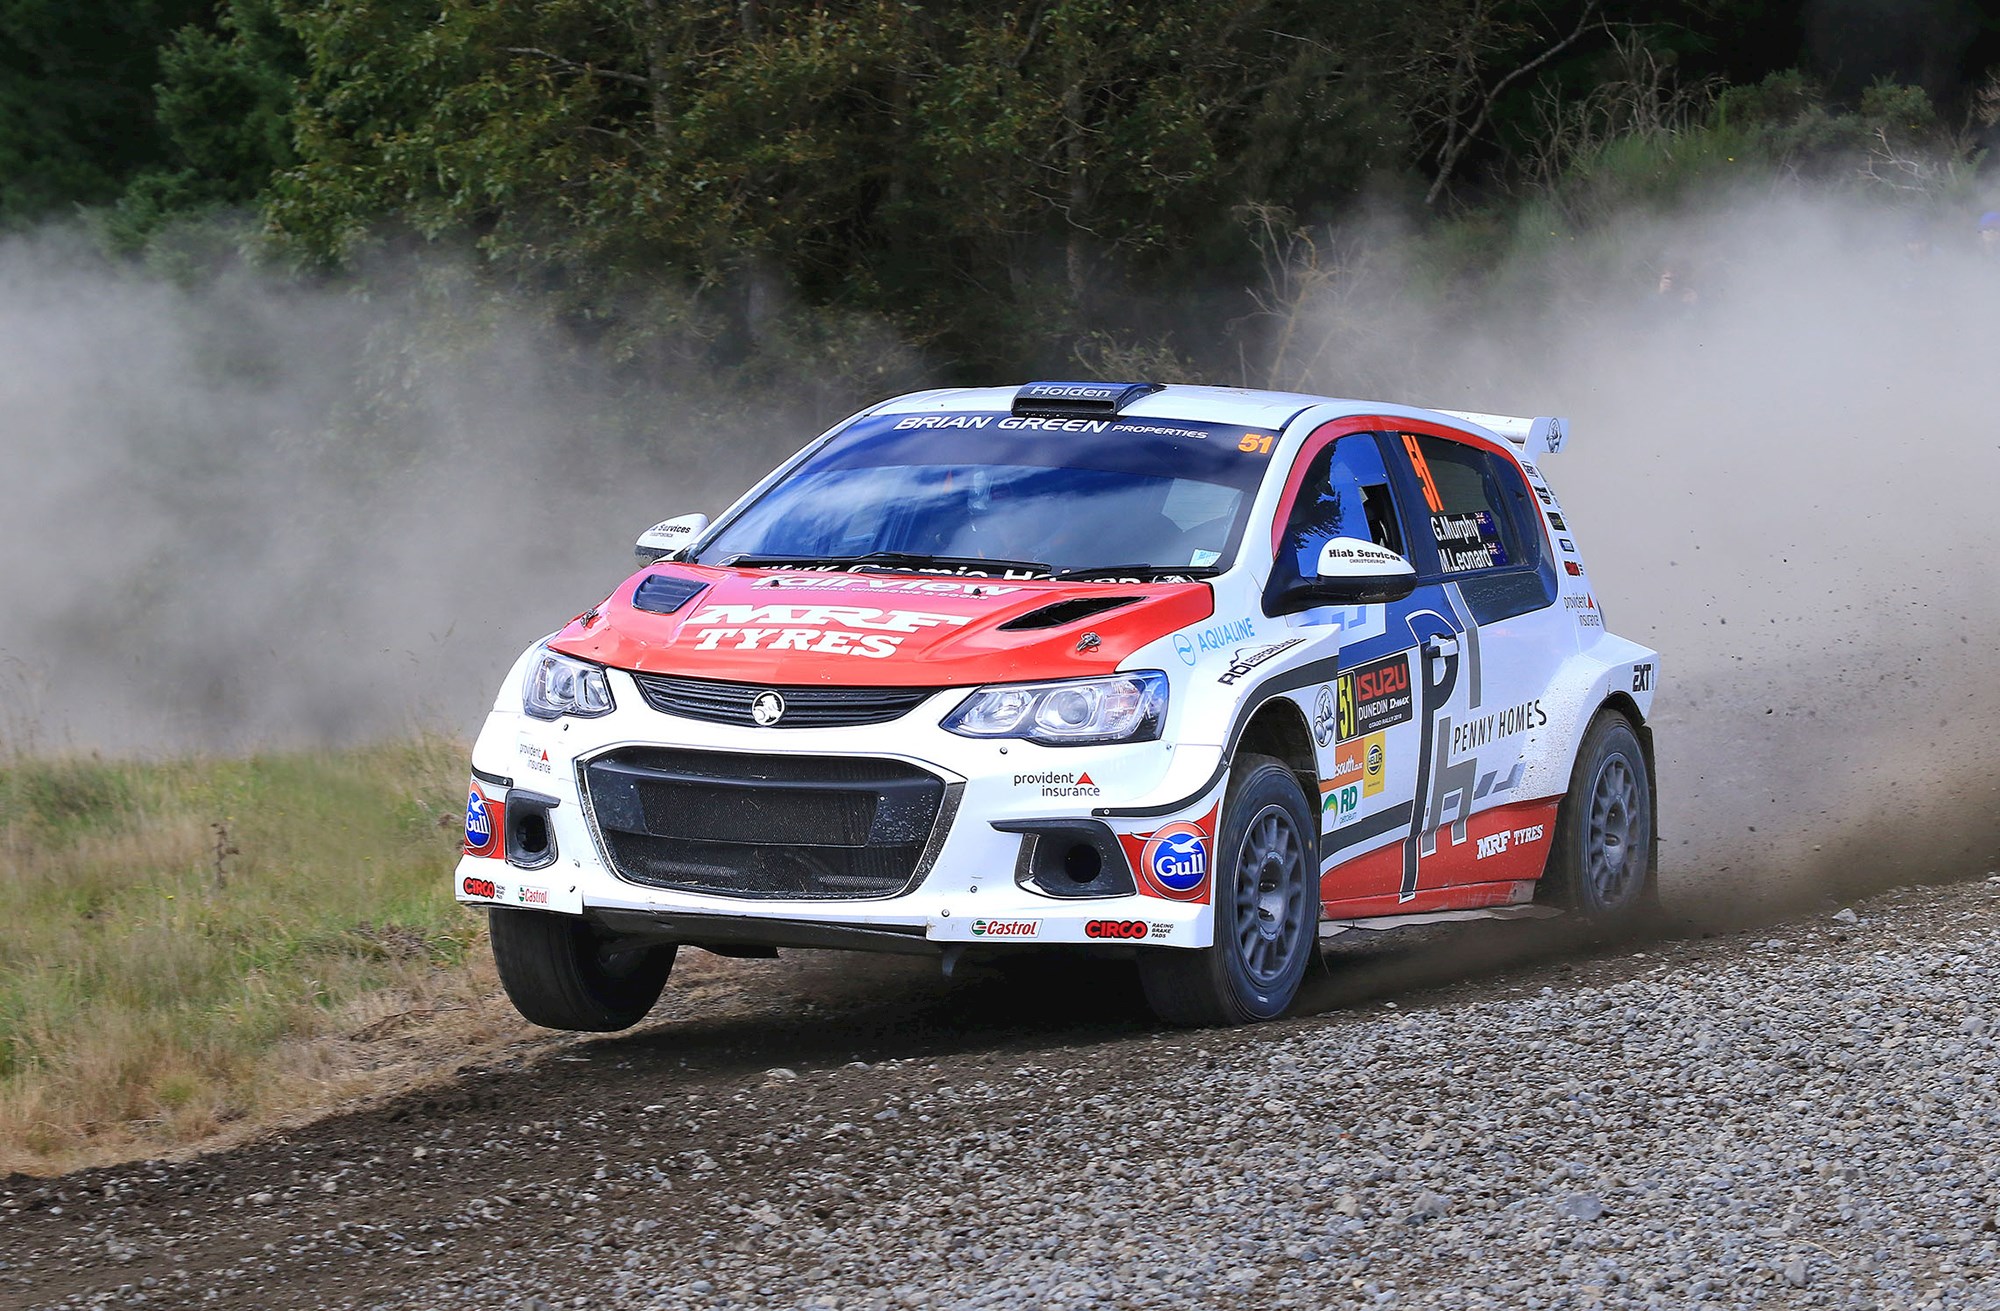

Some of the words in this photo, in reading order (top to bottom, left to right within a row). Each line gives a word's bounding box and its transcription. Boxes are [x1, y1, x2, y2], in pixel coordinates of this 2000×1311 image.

[1029, 385, 1113, 398] Holden
[893, 415, 994, 432] BRIAN
[998, 416, 1111, 434] GREEN
[1112, 424, 1209, 440] PROPERTIES
[1237, 433, 1274, 455] 51
[1401, 435, 1445, 513] 51
[658, 523, 691, 534] Services
[1430, 513, 1482, 544] G.Murphy
[1328, 549, 1354, 558] Hiab
[1357, 549, 1401, 562] Services
[1437, 543, 1494, 574] M.Leonard
[750, 574, 1024, 596] fairview
[684, 604, 976, 634] MRF
[693, 627, 905, 660] TYRES
[1197, 617, 1256, 653] AQUALINE
[1356, 662, 1408, 702] ISUZU
[1338, 674, 1355, 739] 51
[1358, 699, 1388, 721] DUNEDIN
[1453, 713, 1495, 755] PENNY
[1498, 699, 1548, 739] HOMES
[1013, 771, 1075, 787] provident
[1041, 785, 1101, 797] insurance
[1340, 785, 1358, 814] RD
[466, 812, 490, 835] Gull
[1476, 829, 1511, 860] MRF
[1513, 824, 1544, 846] TYRES
[1155, 852, 1207, 877] Gull
[463, 877, 495, 899] CIRCO
[524, 888, 548, 904] Castrol
[986, 920, 1037, 936] Castrol
[1085, 920, 1149, 939] CIRCO
